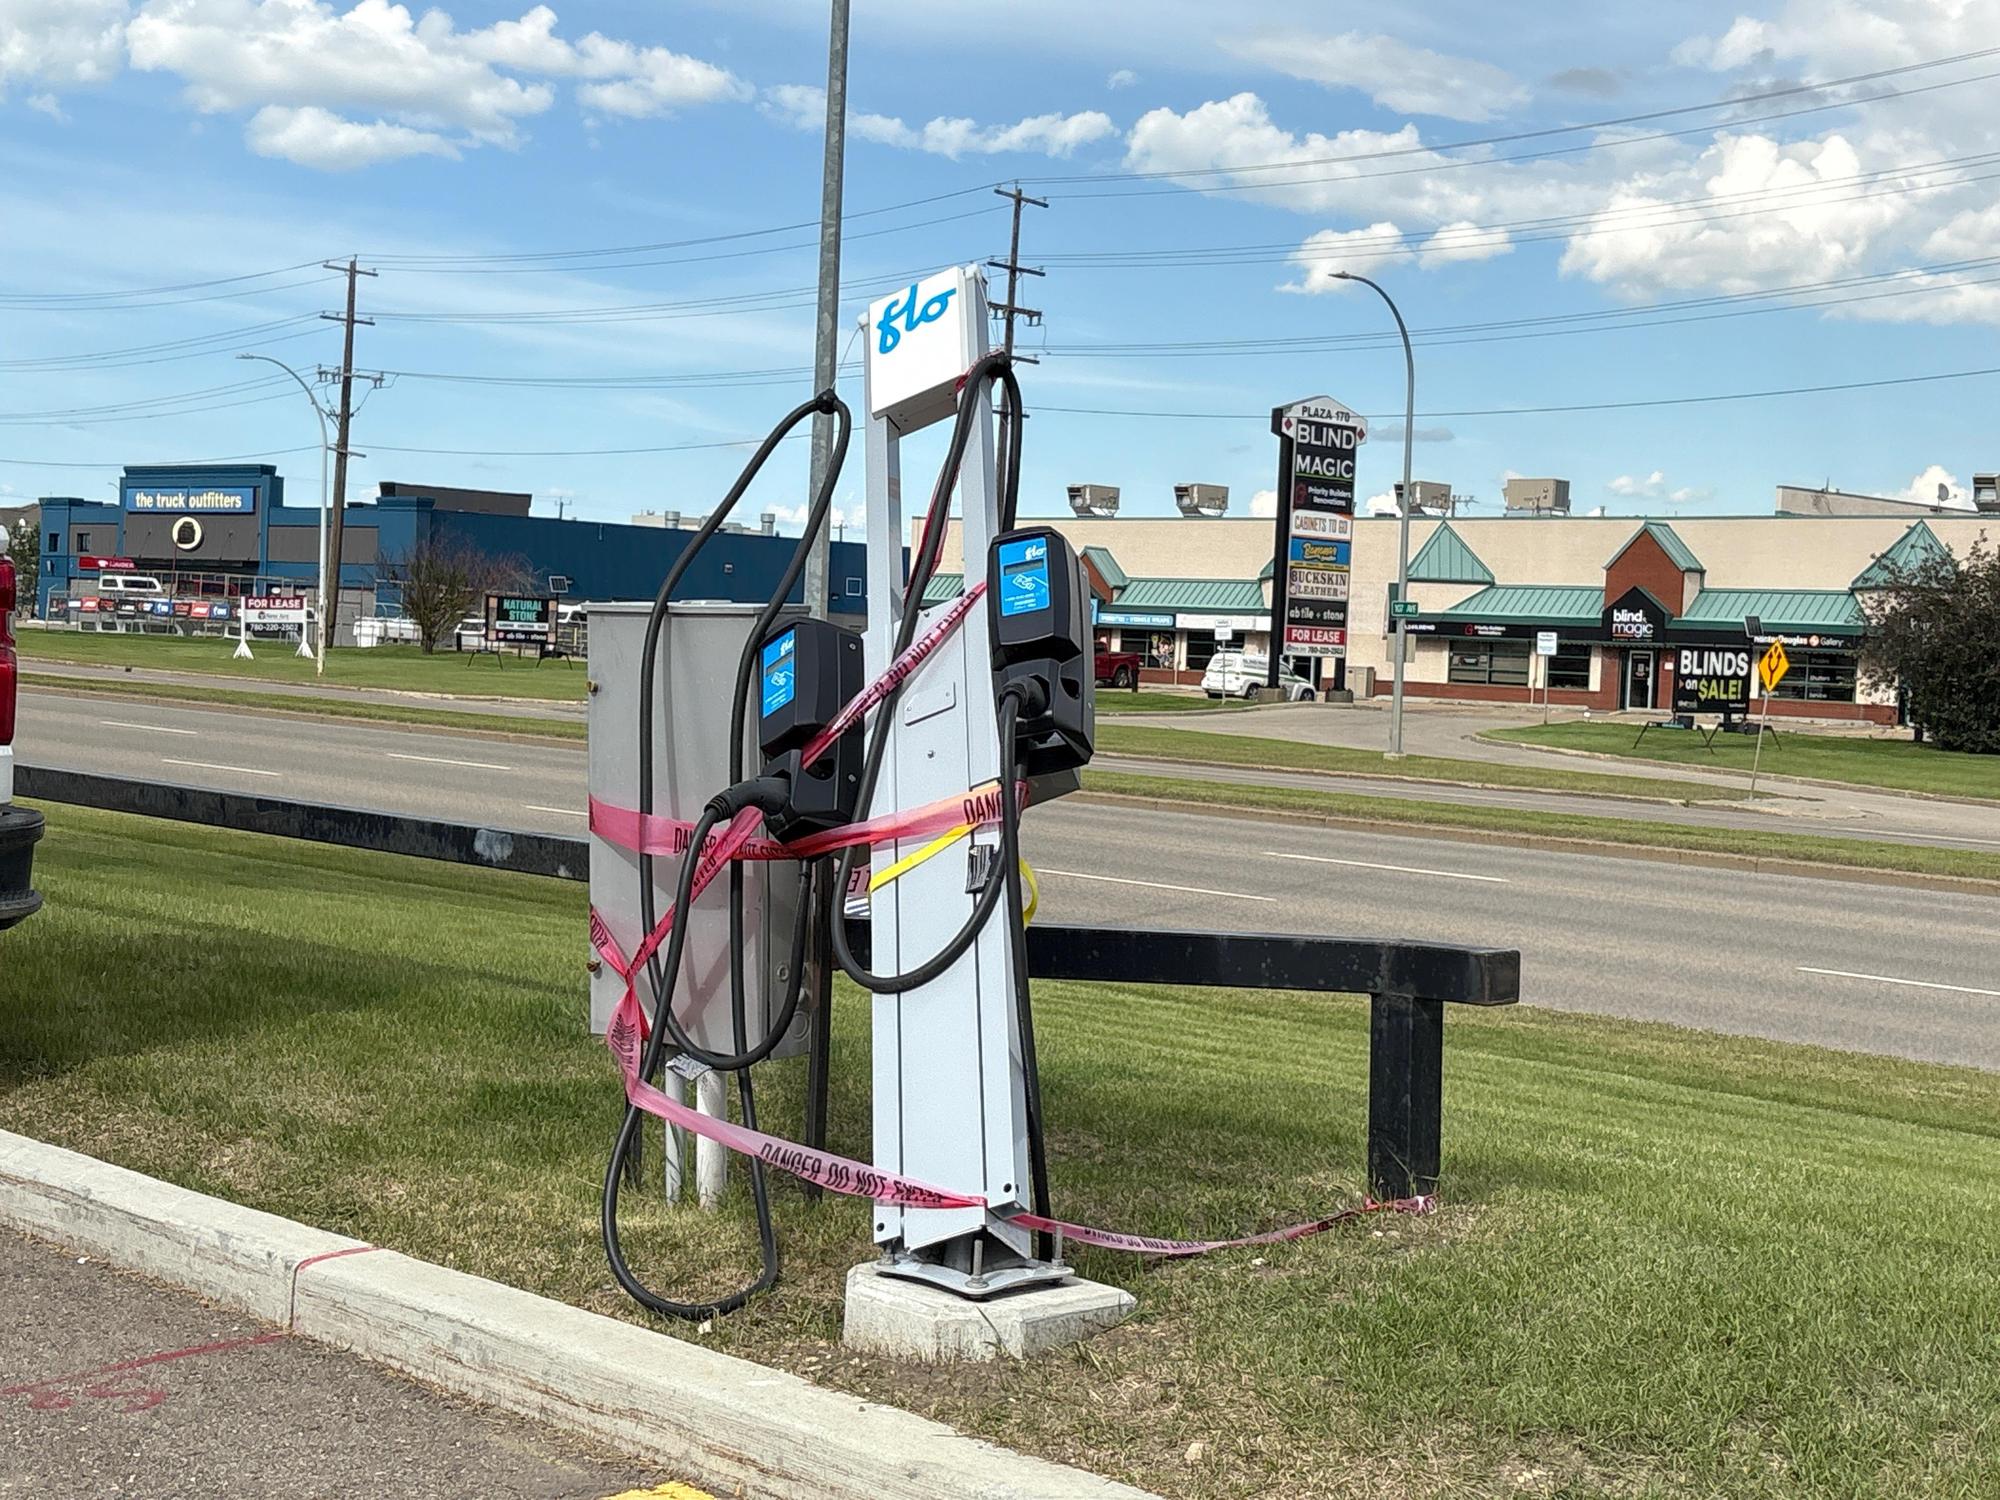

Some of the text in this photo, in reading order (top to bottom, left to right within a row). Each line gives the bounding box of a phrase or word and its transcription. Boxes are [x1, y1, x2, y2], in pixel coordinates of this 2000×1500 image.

[876, 283, 957, 354] flo
[1302, 406, 1351, 422] PLAZA 170
[1297, 423, 1355, 450] BLIND
[1296, 454, 1353, 478] MAGIC
[135, 491, 242, 509] the truck outfitters
[1025, 545, 1048, 560] flo
[1290, 570, 1347, 586] BUCKSKIN
[1297, 585, 1338, 597] LEATHER
[248, 598, 301, 608] FOR LEASE
[503, 598, 543, 612] NATURAL
[509, 610, 538, 622] STONE
[1289, 606, 1300, 619] ab
[1301, 607, 1314, 620] tile
[1323, 609, 1345, 621] stone
[1613, 609, 1643, 622] blind
[1291, 628, 1340, 644] FOR LEASE
[1612, 622, 1654, 638] magic
[1680, 649, 1749, 676] BLINDS
[1685, 677, 1742, 702] on $ALE!
[761, 1142, 822, 1180] DANGER
[824, 1162, 850, 1189] DO
[853, 1169, 888, 1197] NOT
